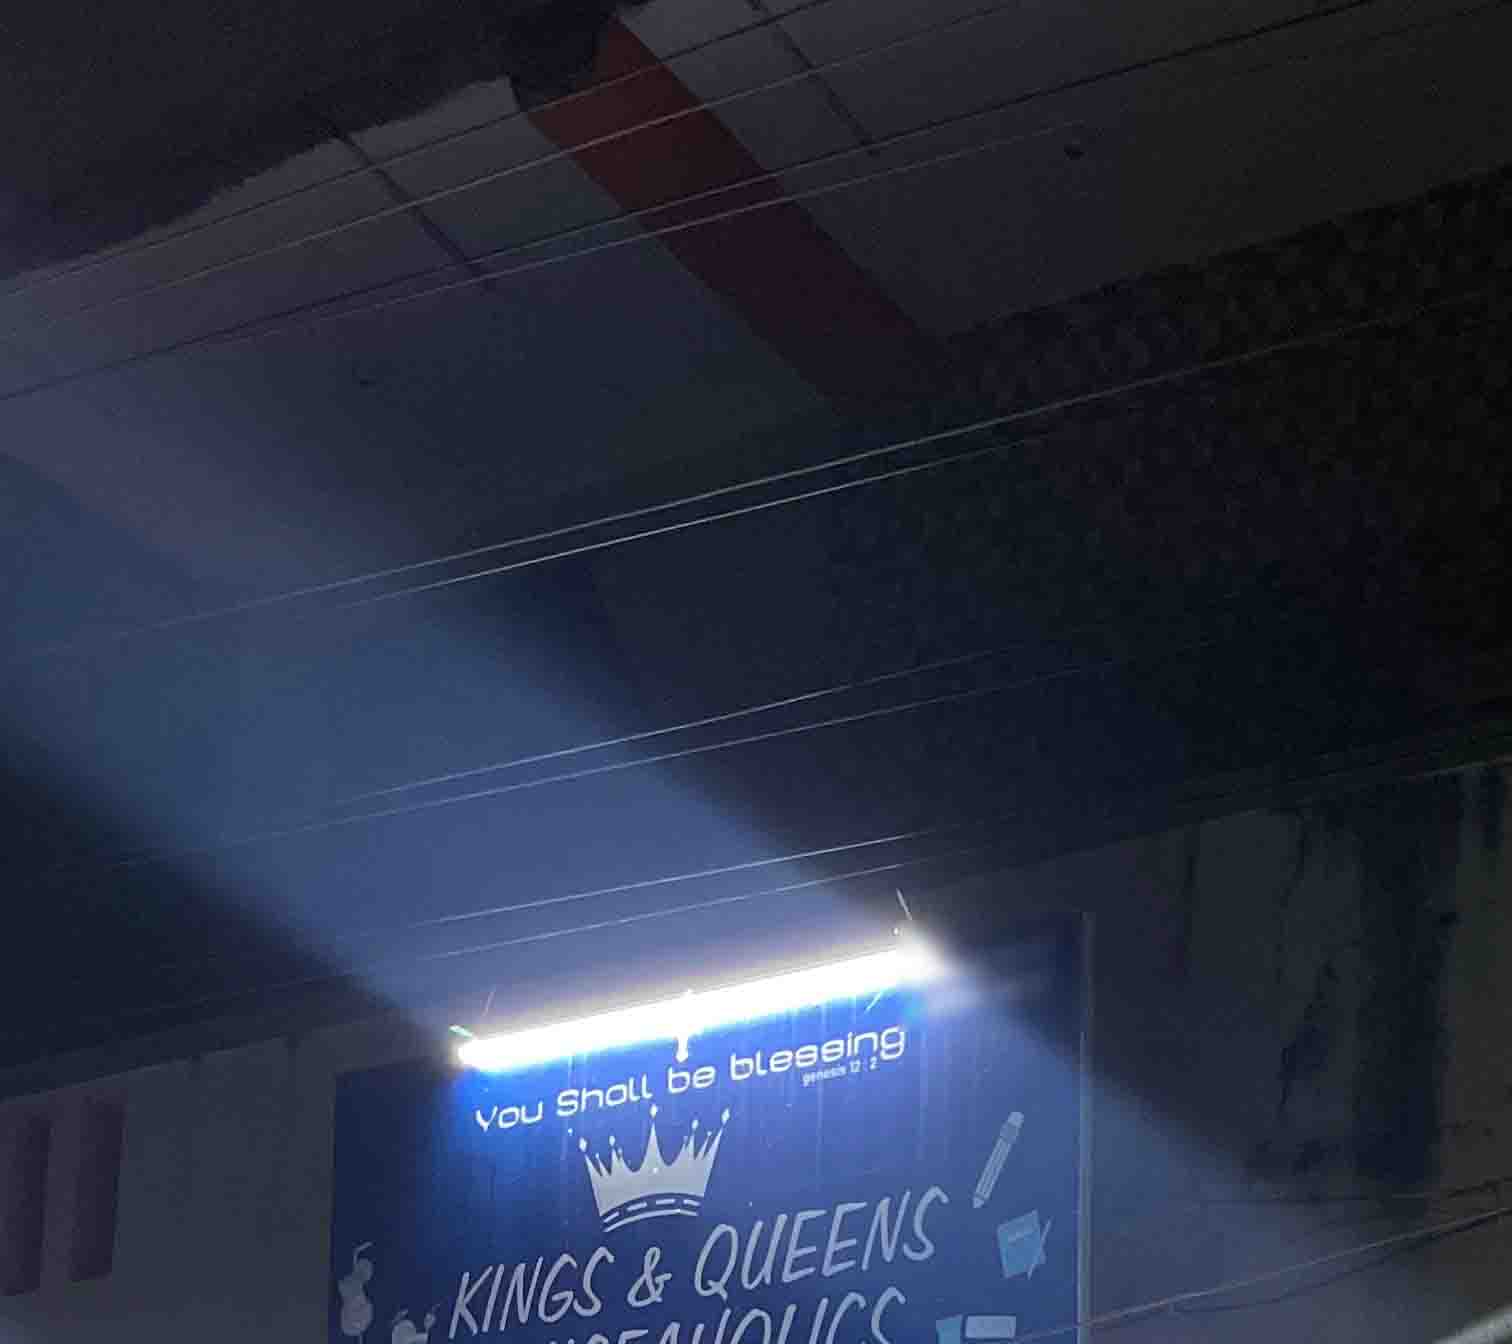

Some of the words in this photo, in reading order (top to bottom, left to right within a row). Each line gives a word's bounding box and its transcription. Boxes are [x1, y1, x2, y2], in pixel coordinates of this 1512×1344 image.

[475, 1100, 544, 1132] You
[667, 1061, 716, 1094] be
[730, 1025, 907, 1081] blessing
[449, 1245, 613, 1340] KINGS
[626, 1245, 673, 1309] &
[693, 1186, 950, 1311] QUEENS
